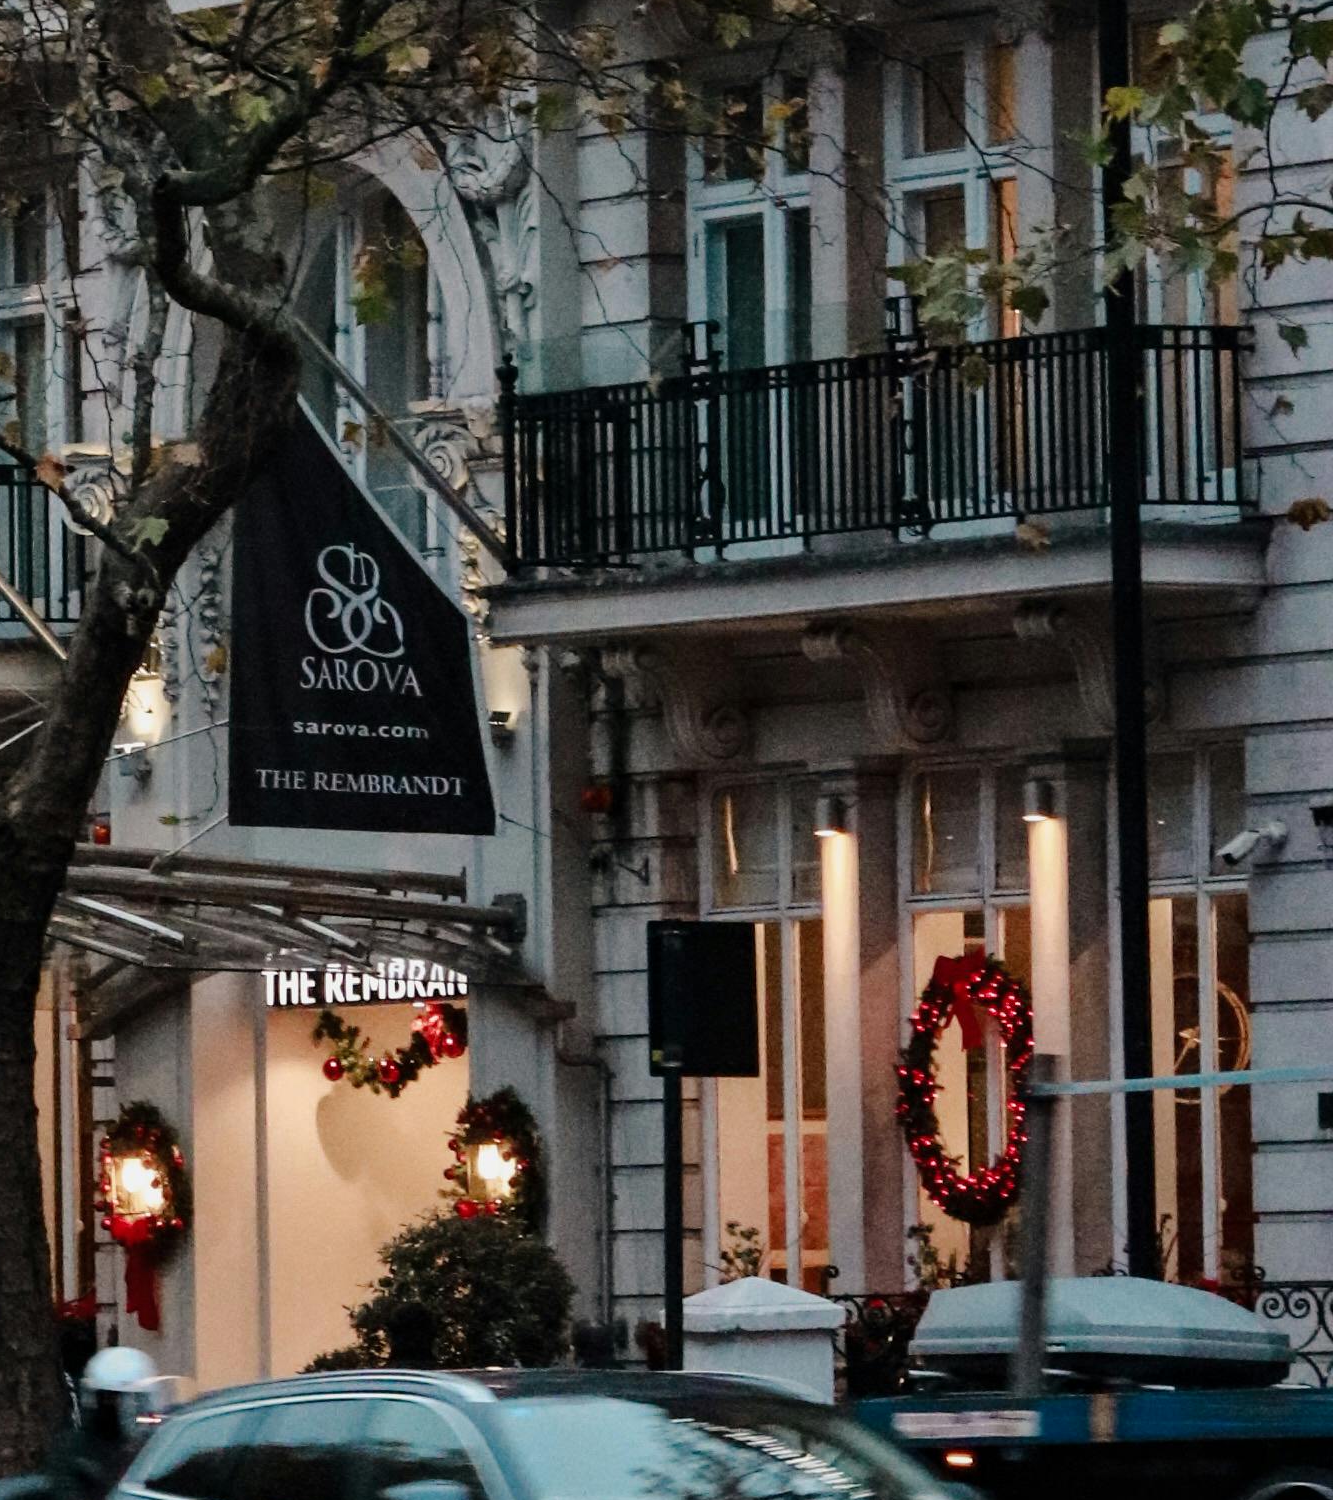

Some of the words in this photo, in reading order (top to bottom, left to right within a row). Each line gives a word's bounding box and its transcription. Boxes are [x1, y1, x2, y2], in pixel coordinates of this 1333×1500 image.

[300, 656, 423, 697] SAROVA
[292, 720, 430, 740] sarova.com
[255, 768, 307, 790] THE
[313, 771, 466, 797] REMBRANDT
[261, 967, 317, 1006] THE
